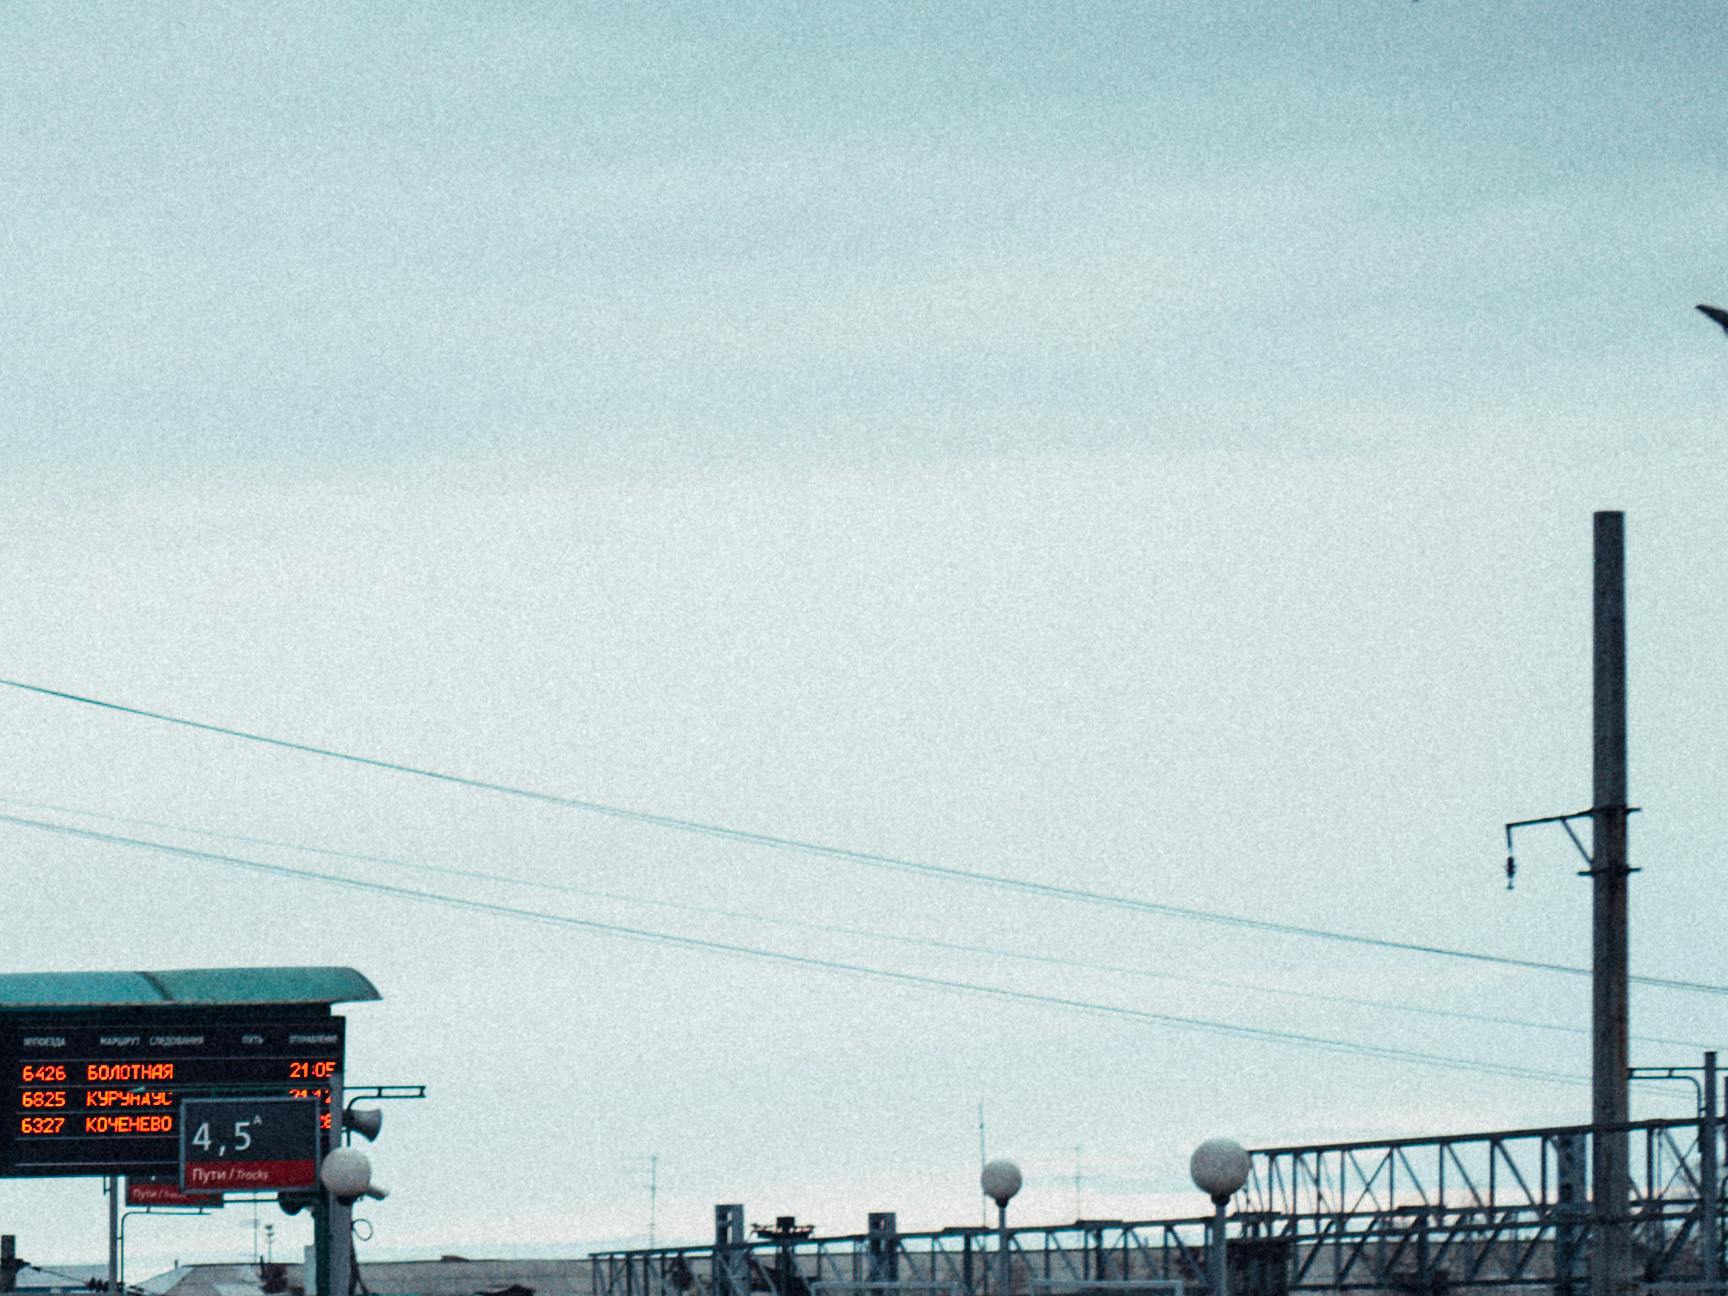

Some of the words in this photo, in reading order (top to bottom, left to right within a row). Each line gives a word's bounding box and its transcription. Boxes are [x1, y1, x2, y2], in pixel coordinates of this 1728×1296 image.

[22, 1065, 67, 1082] 6426
[87, 1063, 174, 1081] БОЛОТНАЯ
[289, 1061, 337, 1079] 21:05
[21, 1091, 67, 1108] 6825
[20, 1117, 66, 1134] 6327
[85, 1115, 173, 1133] КОЧЕНЕВО
[192, 1167, 227, 1184] Пути
